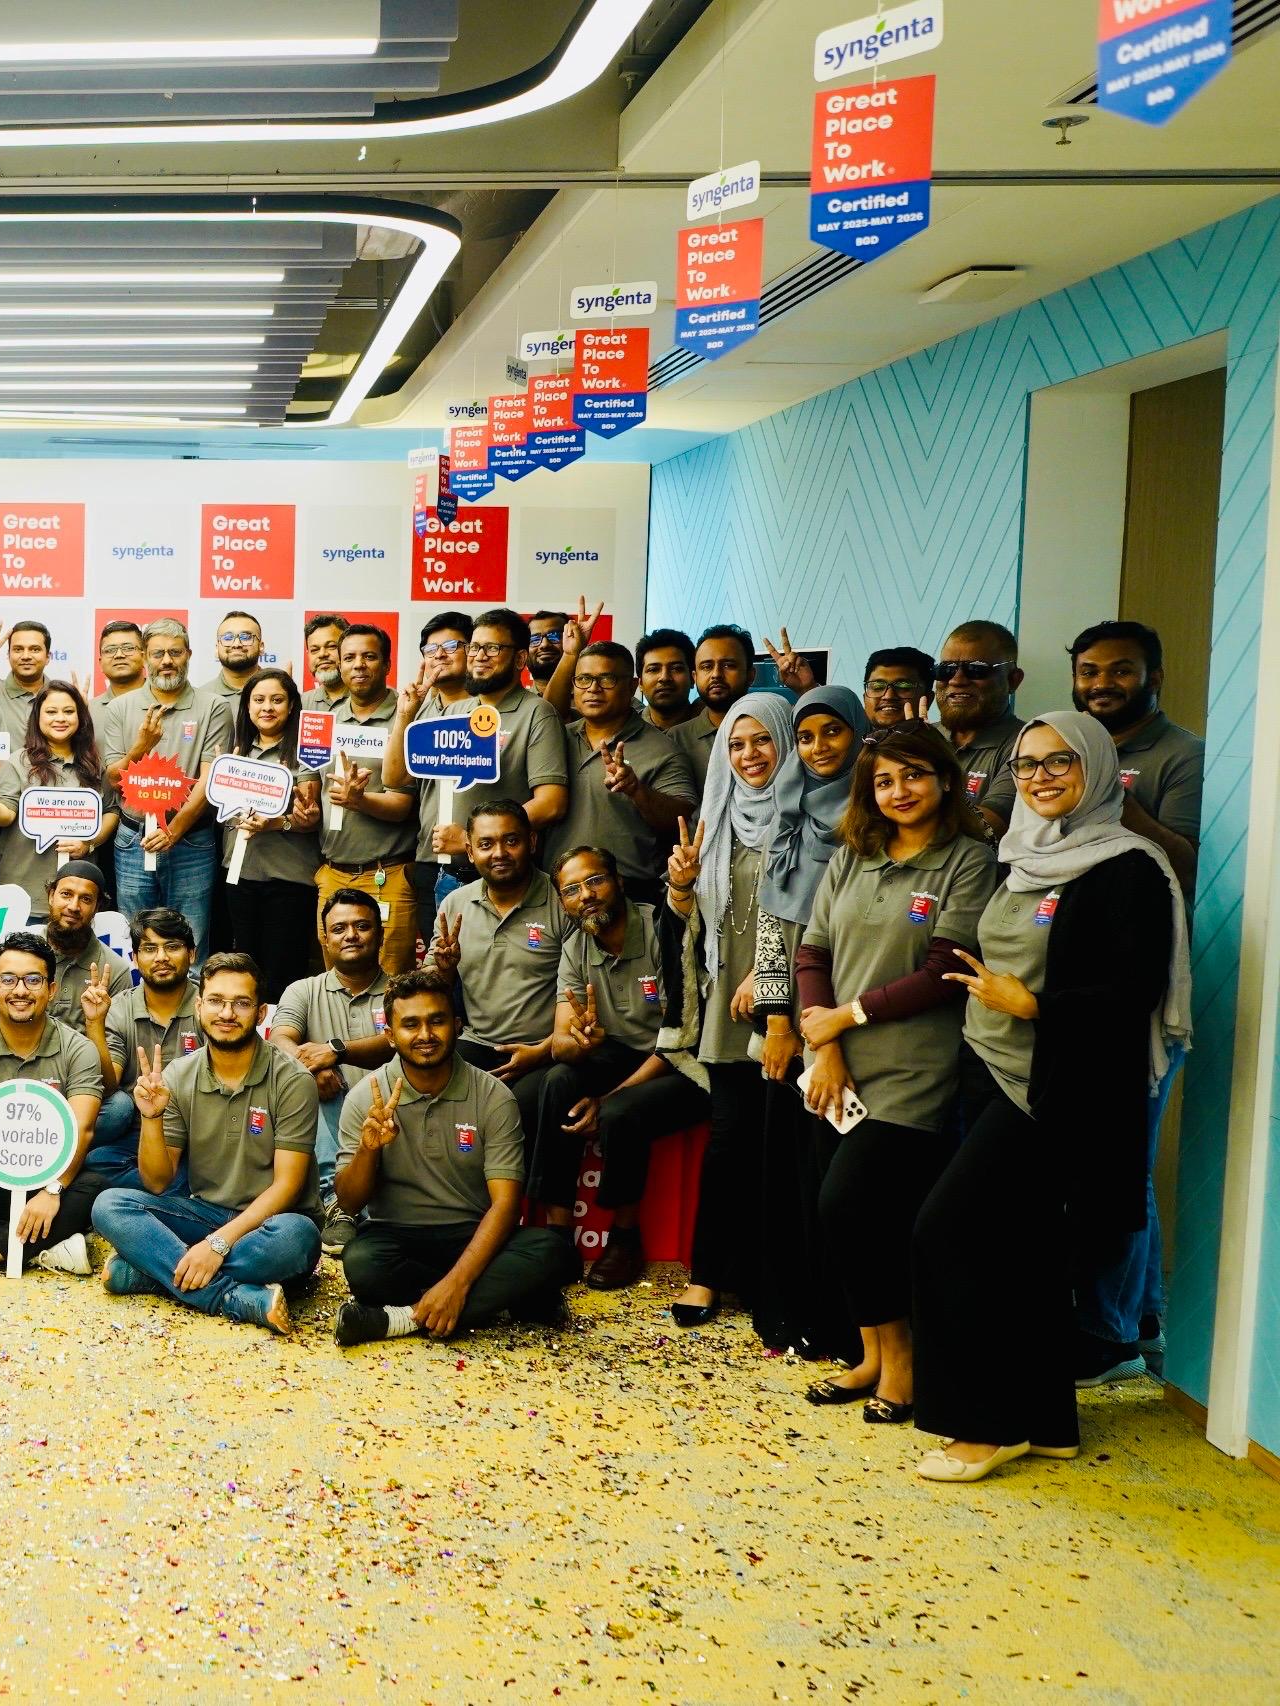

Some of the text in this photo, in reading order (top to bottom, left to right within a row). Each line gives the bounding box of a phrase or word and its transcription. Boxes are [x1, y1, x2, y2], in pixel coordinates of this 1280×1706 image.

[823, 16, 934, 70] syngenta
[1117, 16, 1209, 63] Certified
[826, 89, 897, 113] Great
[826, 115, 893, 137] Place
[824, 142, 851, 160] To
[823, 160, 885, 183] Work
[692, 176, 754, 212] syngenta
[828, 192, 908, 213] Certified
[818, 212, 923, 232] MAY 2025-MAY 2026
[688, 229, 738, 247] Great
[688, 250, 735, 266] Place
[687, 270, 706, 283] To
[686, 284, 729, 301] Work
[577, 291, 652, 313] syngenta
[689, 309, 745, 324] Certified
[583, 334, 627, 345] Great
[526, 339, 576, 356] syngen
[583, 349, 624, 360] Place
[583, 363, 599, 374] To
[535, 378, 569, 390] Great
[582, 378, 620, 389] Work
[494, 399, 525, 408] Great
[534, 392, 567, 402] Place
[585, 399, 634, 408] Certified
[449, 404, 487, 417] syngen
[494, 410, 524, 419] Place
[533, 405, 547, 415] To
[493, 422, 505, 431] To
[533, 417, 563, 427] Work
[456, 430, 482, 438] Great
[493, 433, 520, 442] Work
[535, 435, 576, 444] Certified
[494, 448, 527, 458] Certifie
[455, 459, 478, 467] Work
[3, 514, 60, 529] Great
[213, 515, 270, 531] Great
[4, 534, 57, 549] Place
[213, 535, 267, 551] Place
[425, 538, 479, 553] Place
[111, 543, 175, 561] syngenta
[322, 545, 386, 564] syngenta
[535, 548, 600, 565] syngenta
[3, 553, 25, 568] To
[212, 555, 234, 570] To
[423, 558, 446, 573] To
[2, 574, 52, 588] Work
[212, 575, 262, 590] Work
[423, 578, 473, 593] Work
[336, 736, 383, 748] syngenta
[434, 730, 471, 749] 100%
[412, 753, 492, 767] Survey Participation
[228, 766, 276, 782] We are now
[128, 776, 182, 788] High-Five
[38, 797, 50, 806] We
[138, 790, 172, 800] to Us!
[6, 1102, 42, 1122] 97%
[0, 1149, 44, 1168] Score
